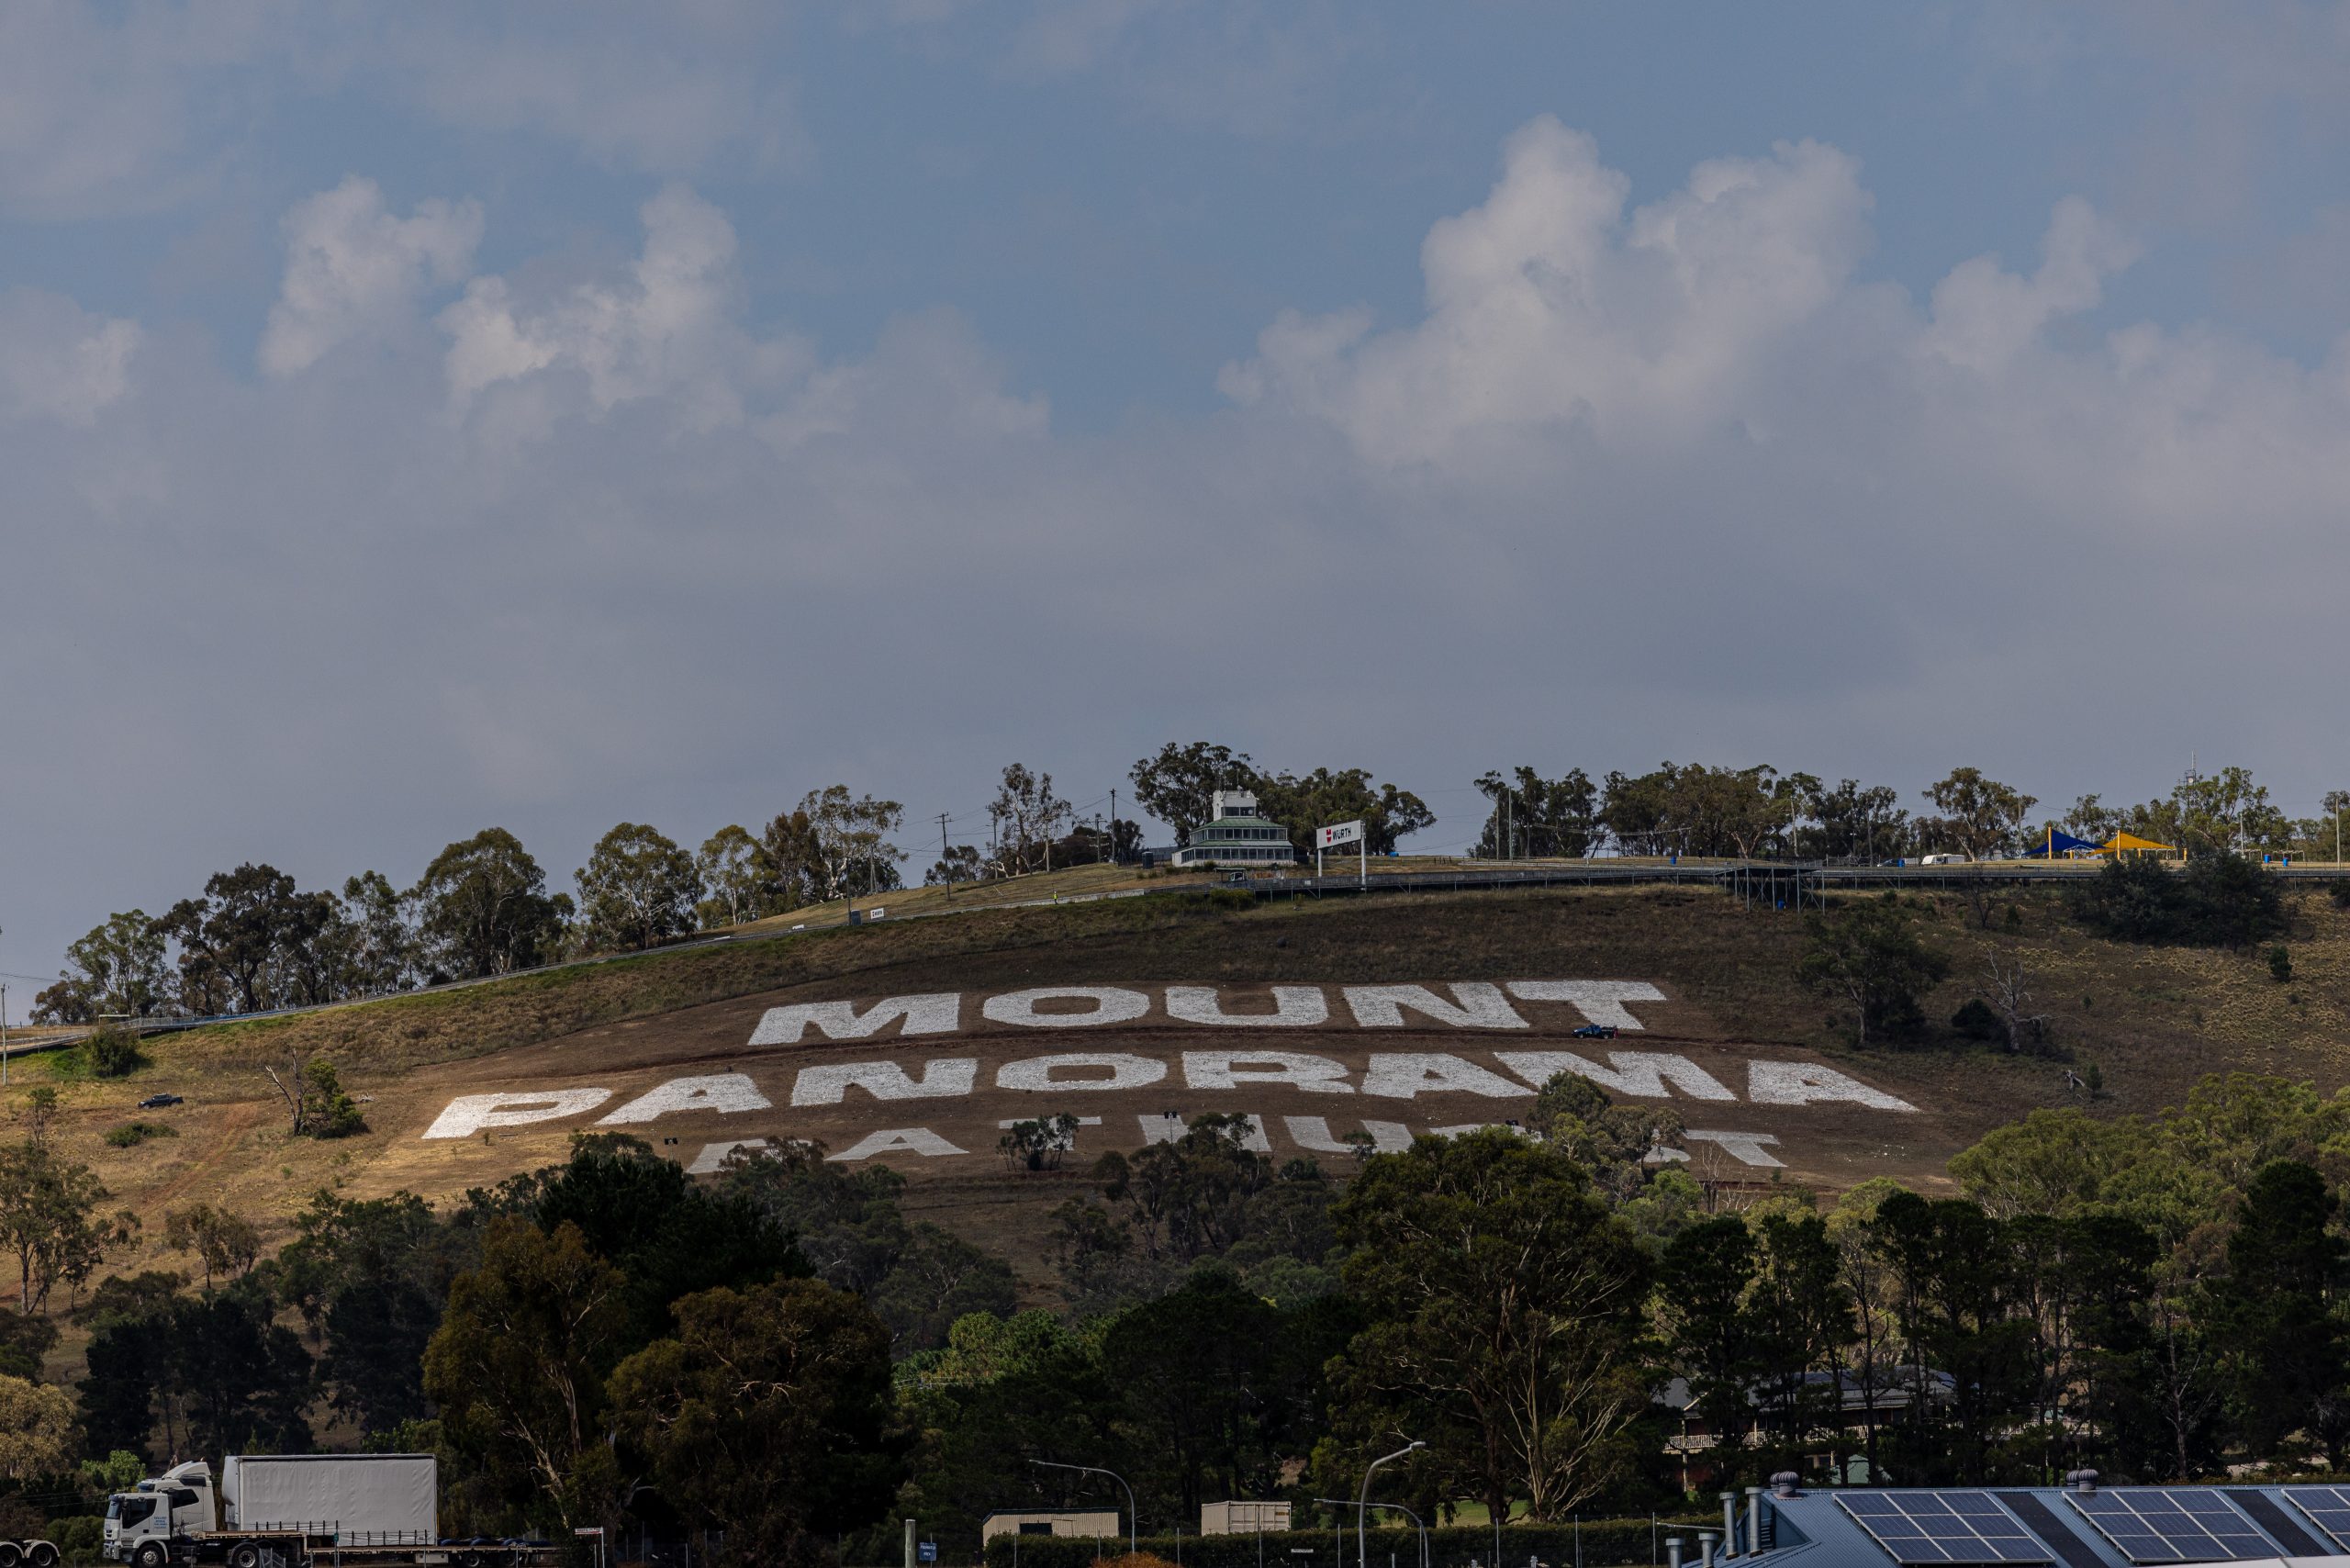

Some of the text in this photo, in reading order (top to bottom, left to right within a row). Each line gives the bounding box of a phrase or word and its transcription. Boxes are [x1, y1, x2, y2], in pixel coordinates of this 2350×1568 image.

[748, 980, 1666, 1046] MOUNT
[423, 1050, 1919, 1138] PANORAMA
[687, 1114, 1785, 1174] ATHUT
